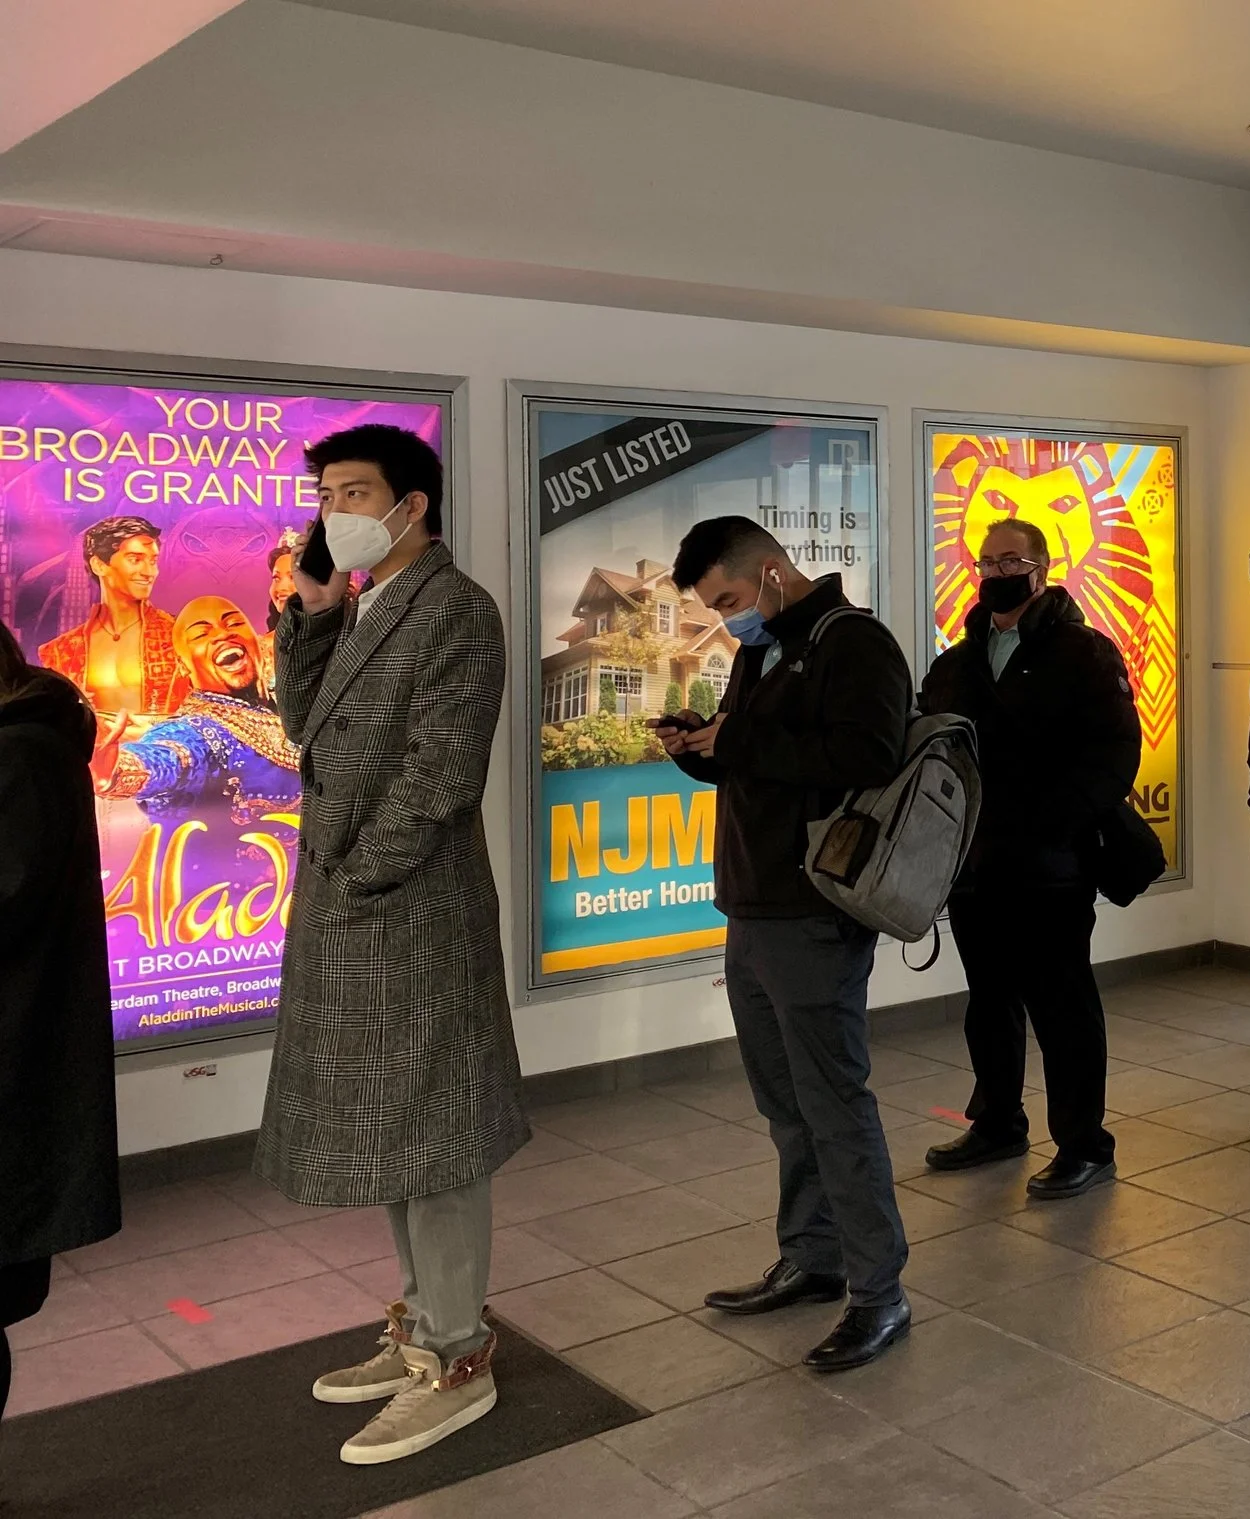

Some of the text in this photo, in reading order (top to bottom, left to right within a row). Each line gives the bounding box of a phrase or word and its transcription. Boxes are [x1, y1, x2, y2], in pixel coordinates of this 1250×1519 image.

[155, 396, 283, 433] YOUR
[0, 426, 288, 470] BROADWAY
[544, 420, 692, 514] JUST LISTED
[63, 468, 320, 507] IS GRANTE
[759, 505, 856, 534] Timing is
[550, 789, 717, 882] NJM
[575, 880, 715, 918] Better Hom
[138, 939, 286, 975] BROADWAY
[162, 985, 222, 1003] Theatre,
[227, 976, 281, 994] Broadw
